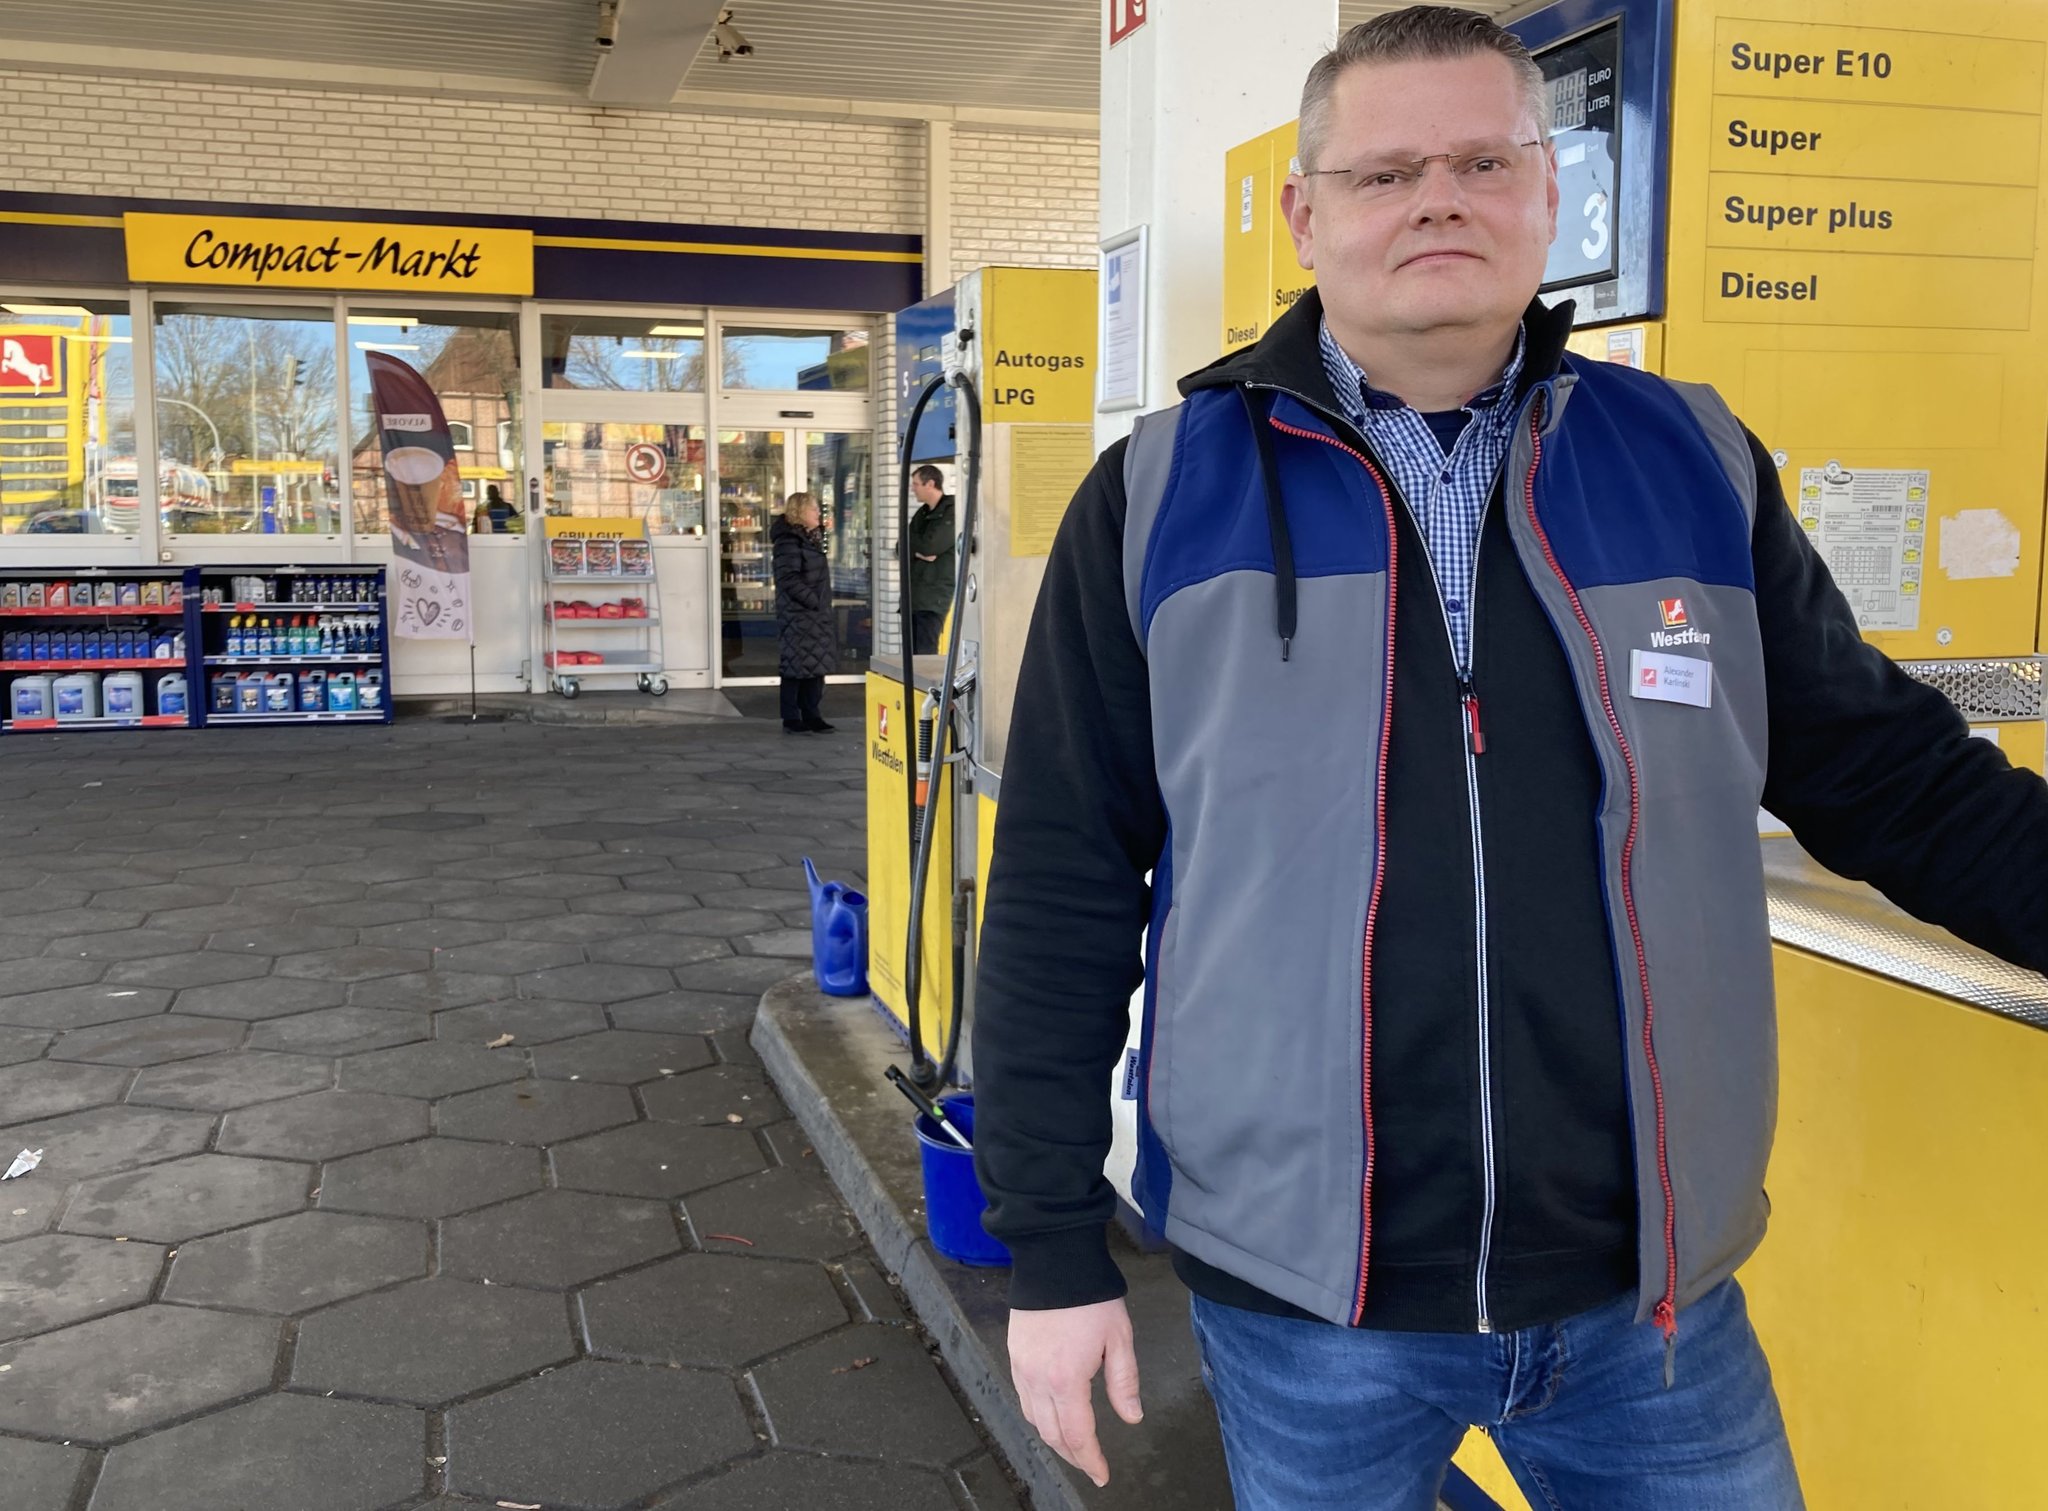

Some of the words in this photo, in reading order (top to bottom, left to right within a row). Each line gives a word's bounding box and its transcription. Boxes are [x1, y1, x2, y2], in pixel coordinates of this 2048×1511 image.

[1588, 67, 1612, 86] EURO
[1731, 42, 1825, 79] Super
[1836, 49, 1892, 79] E10
[1587, 94, 1611, 113] LITER
[1728, 120, 1822, 156] Super
[1581, 192, 1609, 260] 3
[1724, 195, 1819, 231] Super
[1828, 202, 1893, 233] plus
[184, 229, 481, 282] Compact-Markt
[1721, 271, 1818, 301] Diesel
[1227, 323, 1258, 344] Diesel
[994, 350, 1084, 372] Autogas
[994, 388, 1035, 405] LPG
[1663, 665, 1694, 679] Alexander
[872, 740, 904, 775] Westfalen
[1125, 1056, 1138, 1096] Westfalen
